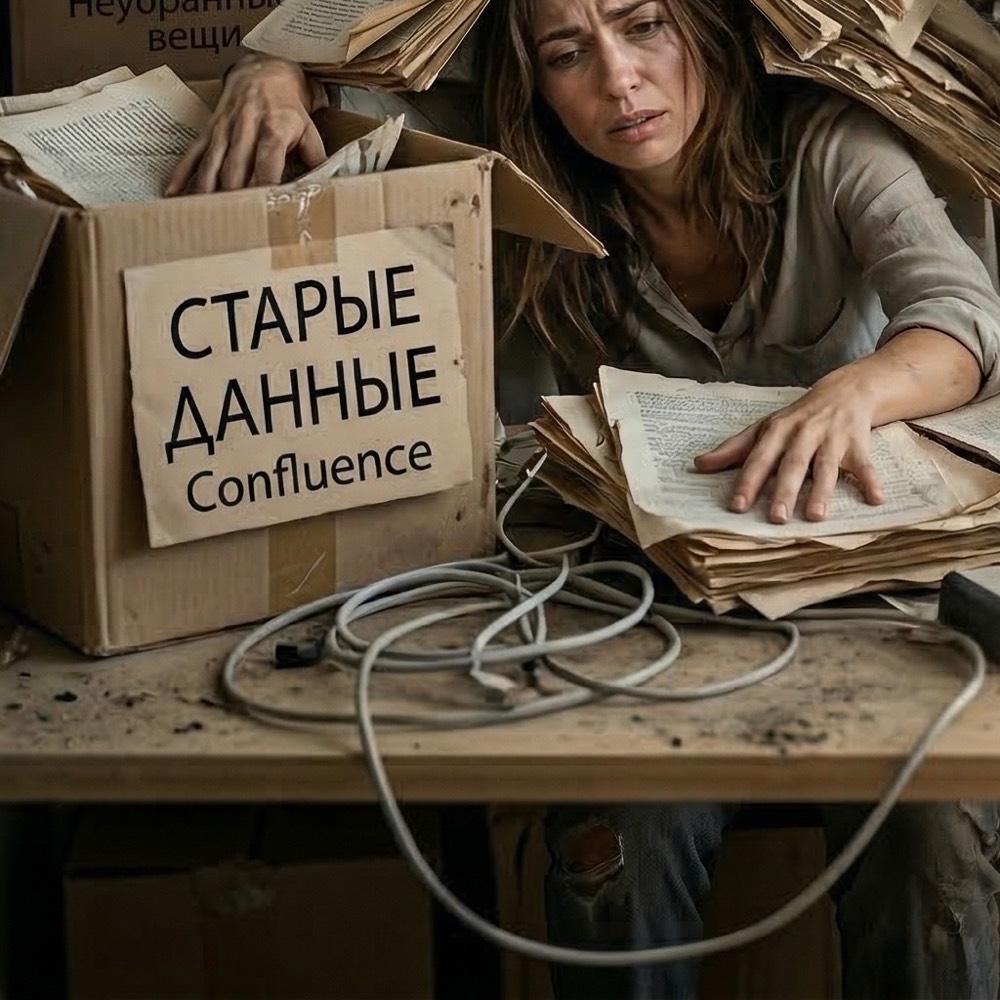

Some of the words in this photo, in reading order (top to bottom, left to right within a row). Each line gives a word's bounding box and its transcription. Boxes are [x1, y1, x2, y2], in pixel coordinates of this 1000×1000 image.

[149, 25, 241, 54] вещи
[170, 264, 421, 360] СТАРЫЕ
[165, 345, 441, 464] ДАННЫЕ
[187, 440, 433, 512] Confluence
